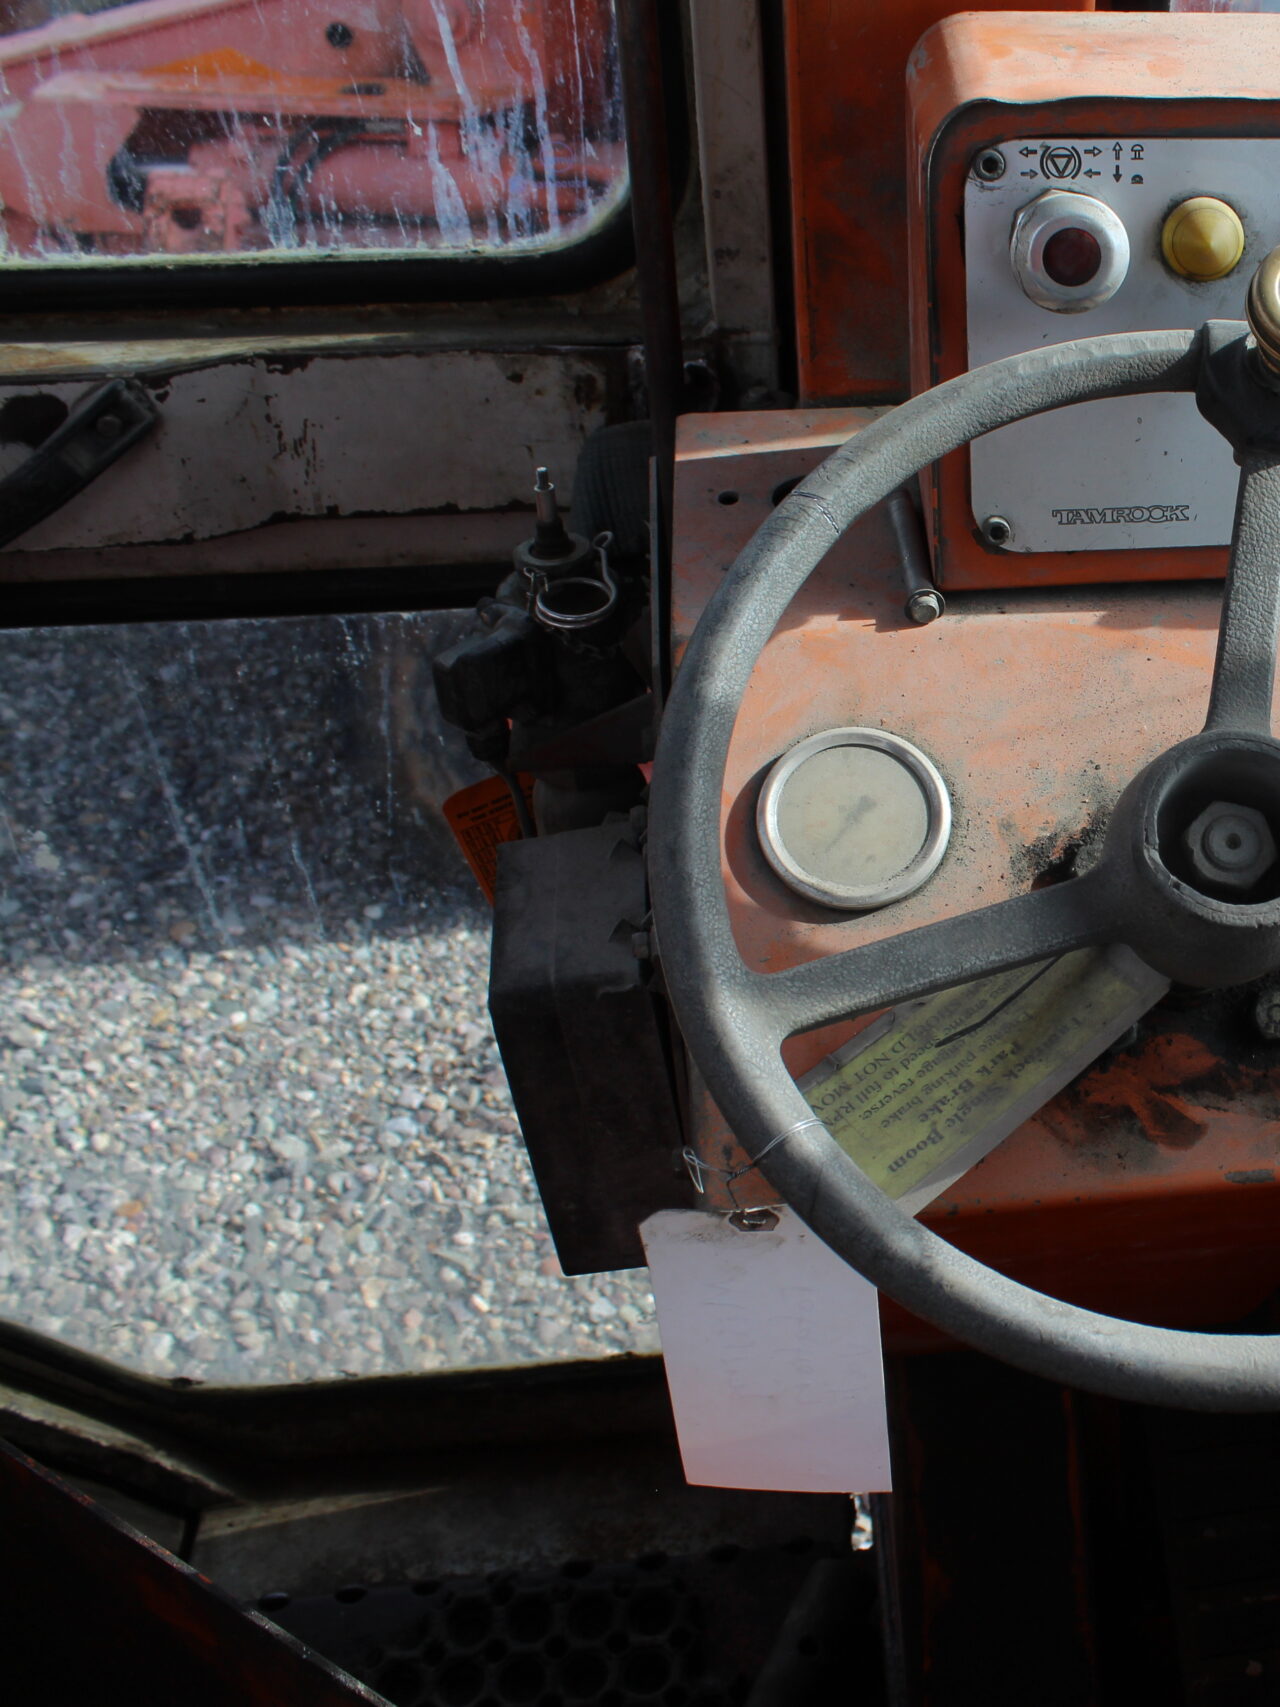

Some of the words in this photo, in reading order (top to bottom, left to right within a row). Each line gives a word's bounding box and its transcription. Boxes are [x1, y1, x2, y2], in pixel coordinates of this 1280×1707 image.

[1052, 505, 1190, 525] TAMROCK
[851, 1050, 889, 1084] NOT
[882, 1067, 898, 1082] to
[921, 1050, 976, 1098] parking
[977, 1039, 1022, 1080] Park
[810, 1078, 852, 1115] MOV
[855, 1079, 881, 1103] full
[918, 1077, 973, 1125] Brake
[880, 1094, 921, 1130] brake
[888, 1128, 942, 1176] Boom
